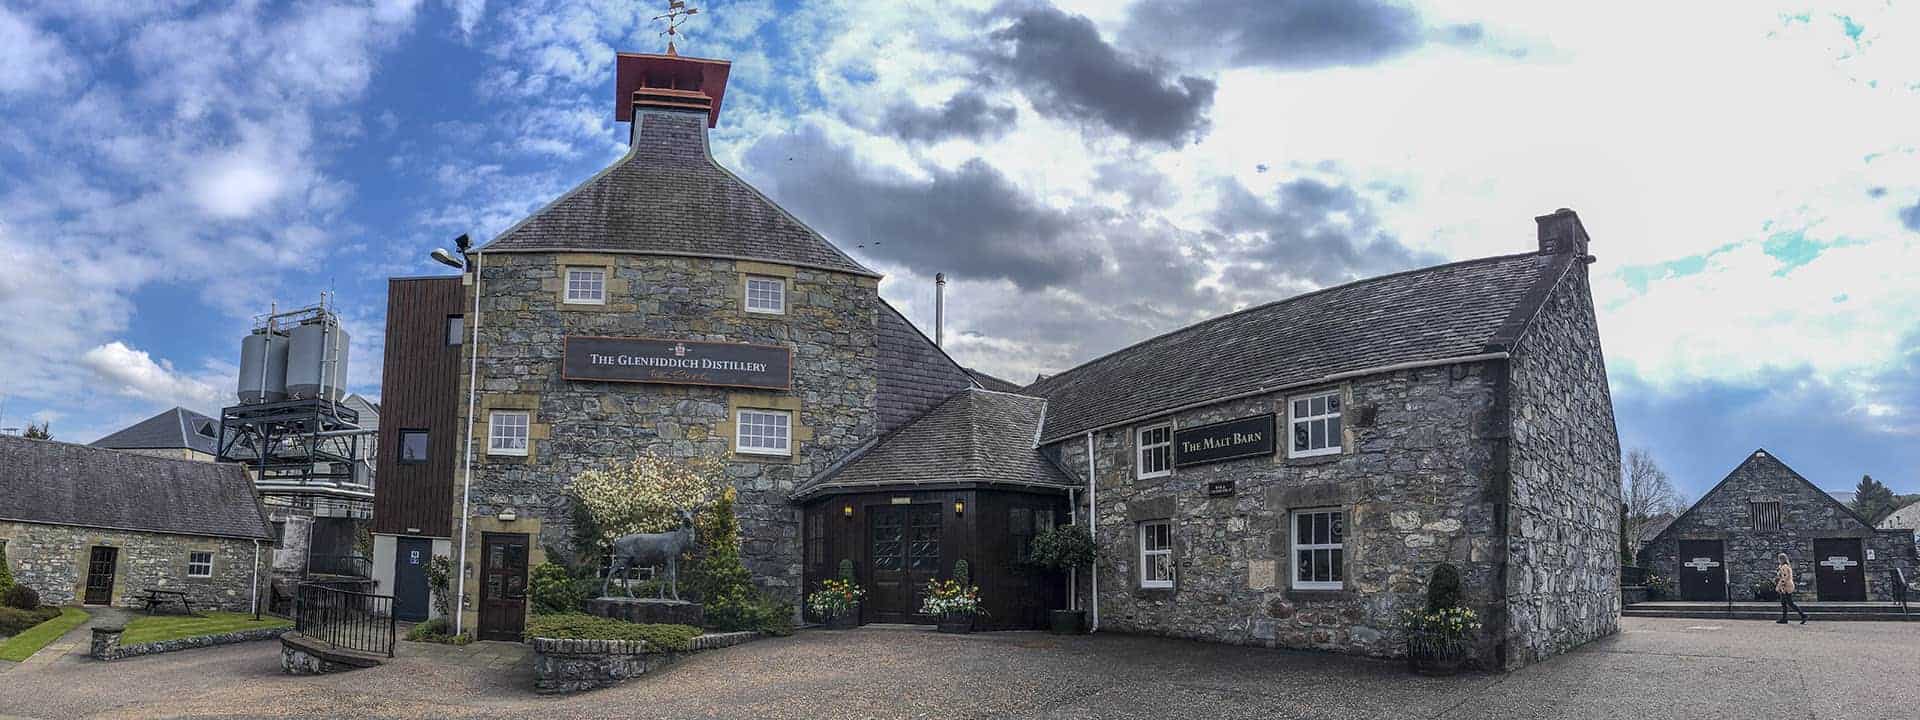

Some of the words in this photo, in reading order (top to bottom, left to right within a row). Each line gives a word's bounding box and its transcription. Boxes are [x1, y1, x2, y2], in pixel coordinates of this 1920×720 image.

[590, 353, 615, 365] THE
[618, 354, 698, 369] GLENFIDDICH
[702, 358, 767, 372] DISTILLERY
[1182, 441, 1201, 453] THE
[1203, 437, 1231, 450] MALT
[1233, 432, 1262, 445] BARN
